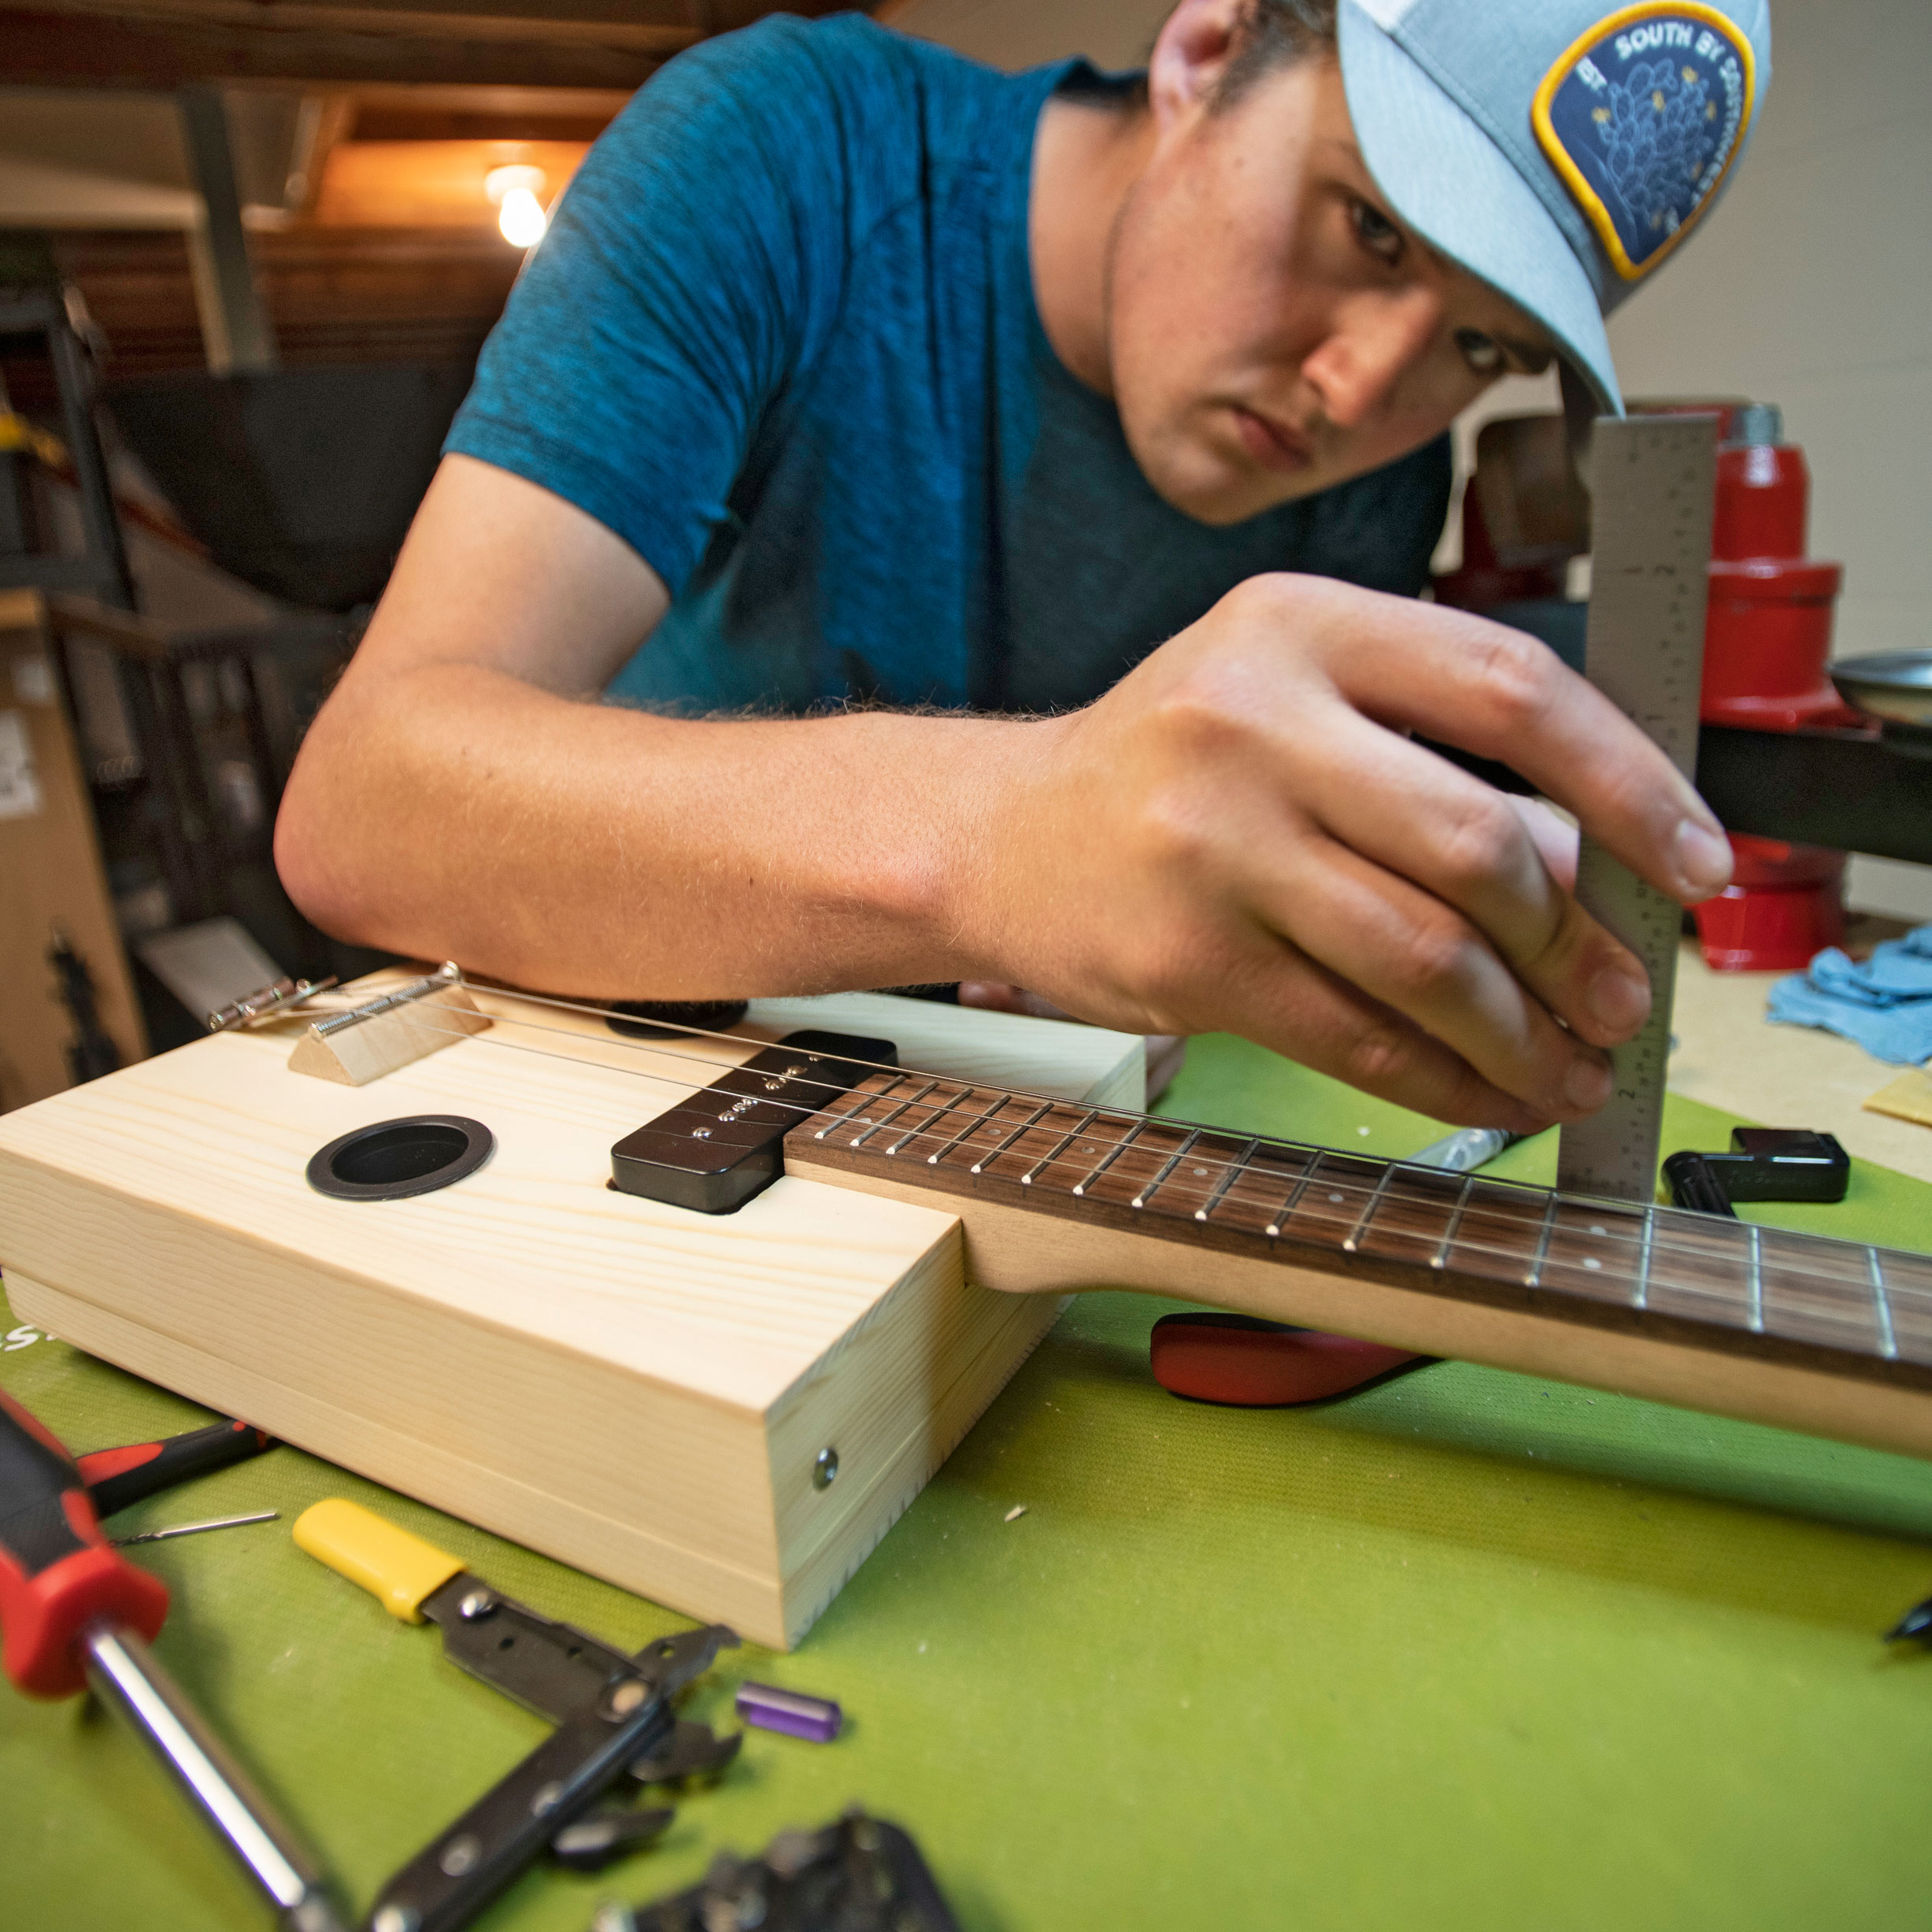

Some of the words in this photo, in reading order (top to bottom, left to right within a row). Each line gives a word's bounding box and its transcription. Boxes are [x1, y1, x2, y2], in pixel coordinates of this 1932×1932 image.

[1614, 21, 1693, 60] SOUTH
[1695, 30, 1726, 61] BY
[1618, 1088, 1636, 1100] 2
